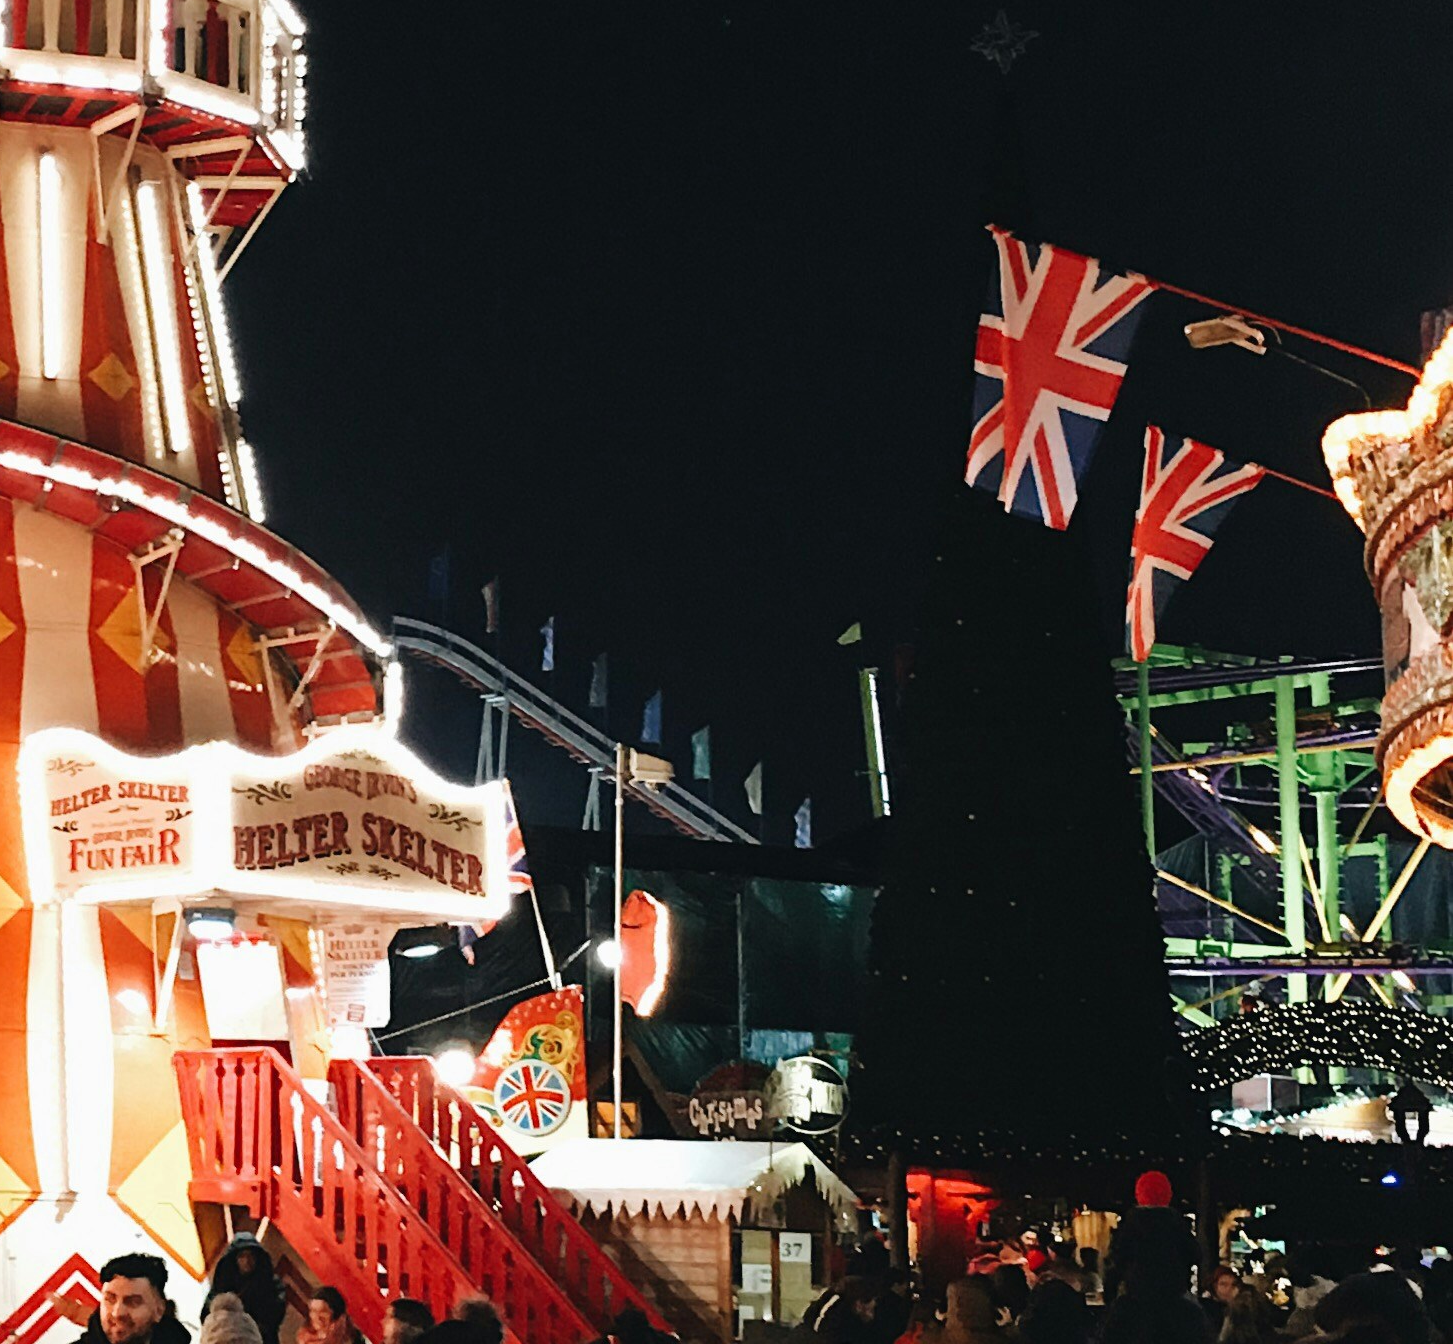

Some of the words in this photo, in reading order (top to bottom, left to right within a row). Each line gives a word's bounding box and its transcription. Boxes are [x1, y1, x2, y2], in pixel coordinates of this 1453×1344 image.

[50, 784, 112, 816] HELTER
[117, 781, 189, 803] SKELTER
[303, 764, 363, 798] GEORGE
[68, 838, 114, 873] FUN
[120, 828, 181, 868] FAIR
[233, 811, 352, 871] HELTER
[361, 812, 486, 897] SKELTER
[689, 1097, 763, 1136] Christmas
[781, 1242, 803, 1258] 37
